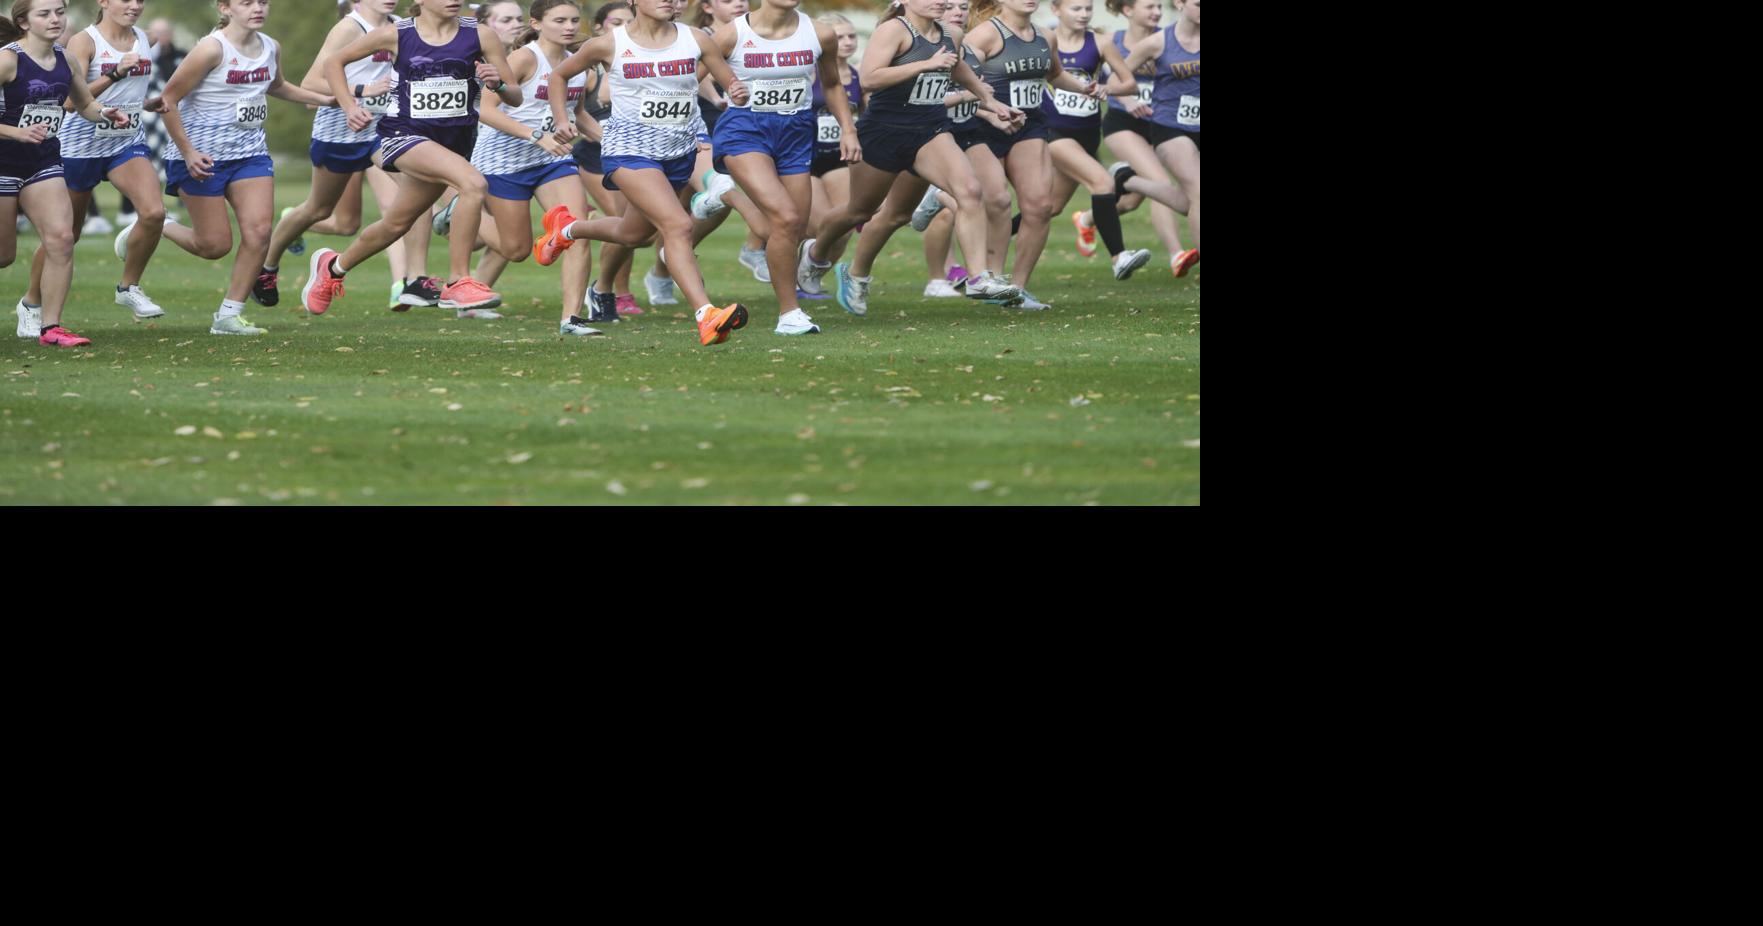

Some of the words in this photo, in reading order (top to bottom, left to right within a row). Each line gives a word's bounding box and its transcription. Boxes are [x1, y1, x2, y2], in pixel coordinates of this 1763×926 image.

[744, 53, 774, 68] SIOUX
[623, 63, 656, 79] SIOUX
[413, 91, 466, 110] 3829
[753, 88, 804, 106] 3847
[239, 104, 266, 122] 3848
[641, 101, 691, 118] 3844
